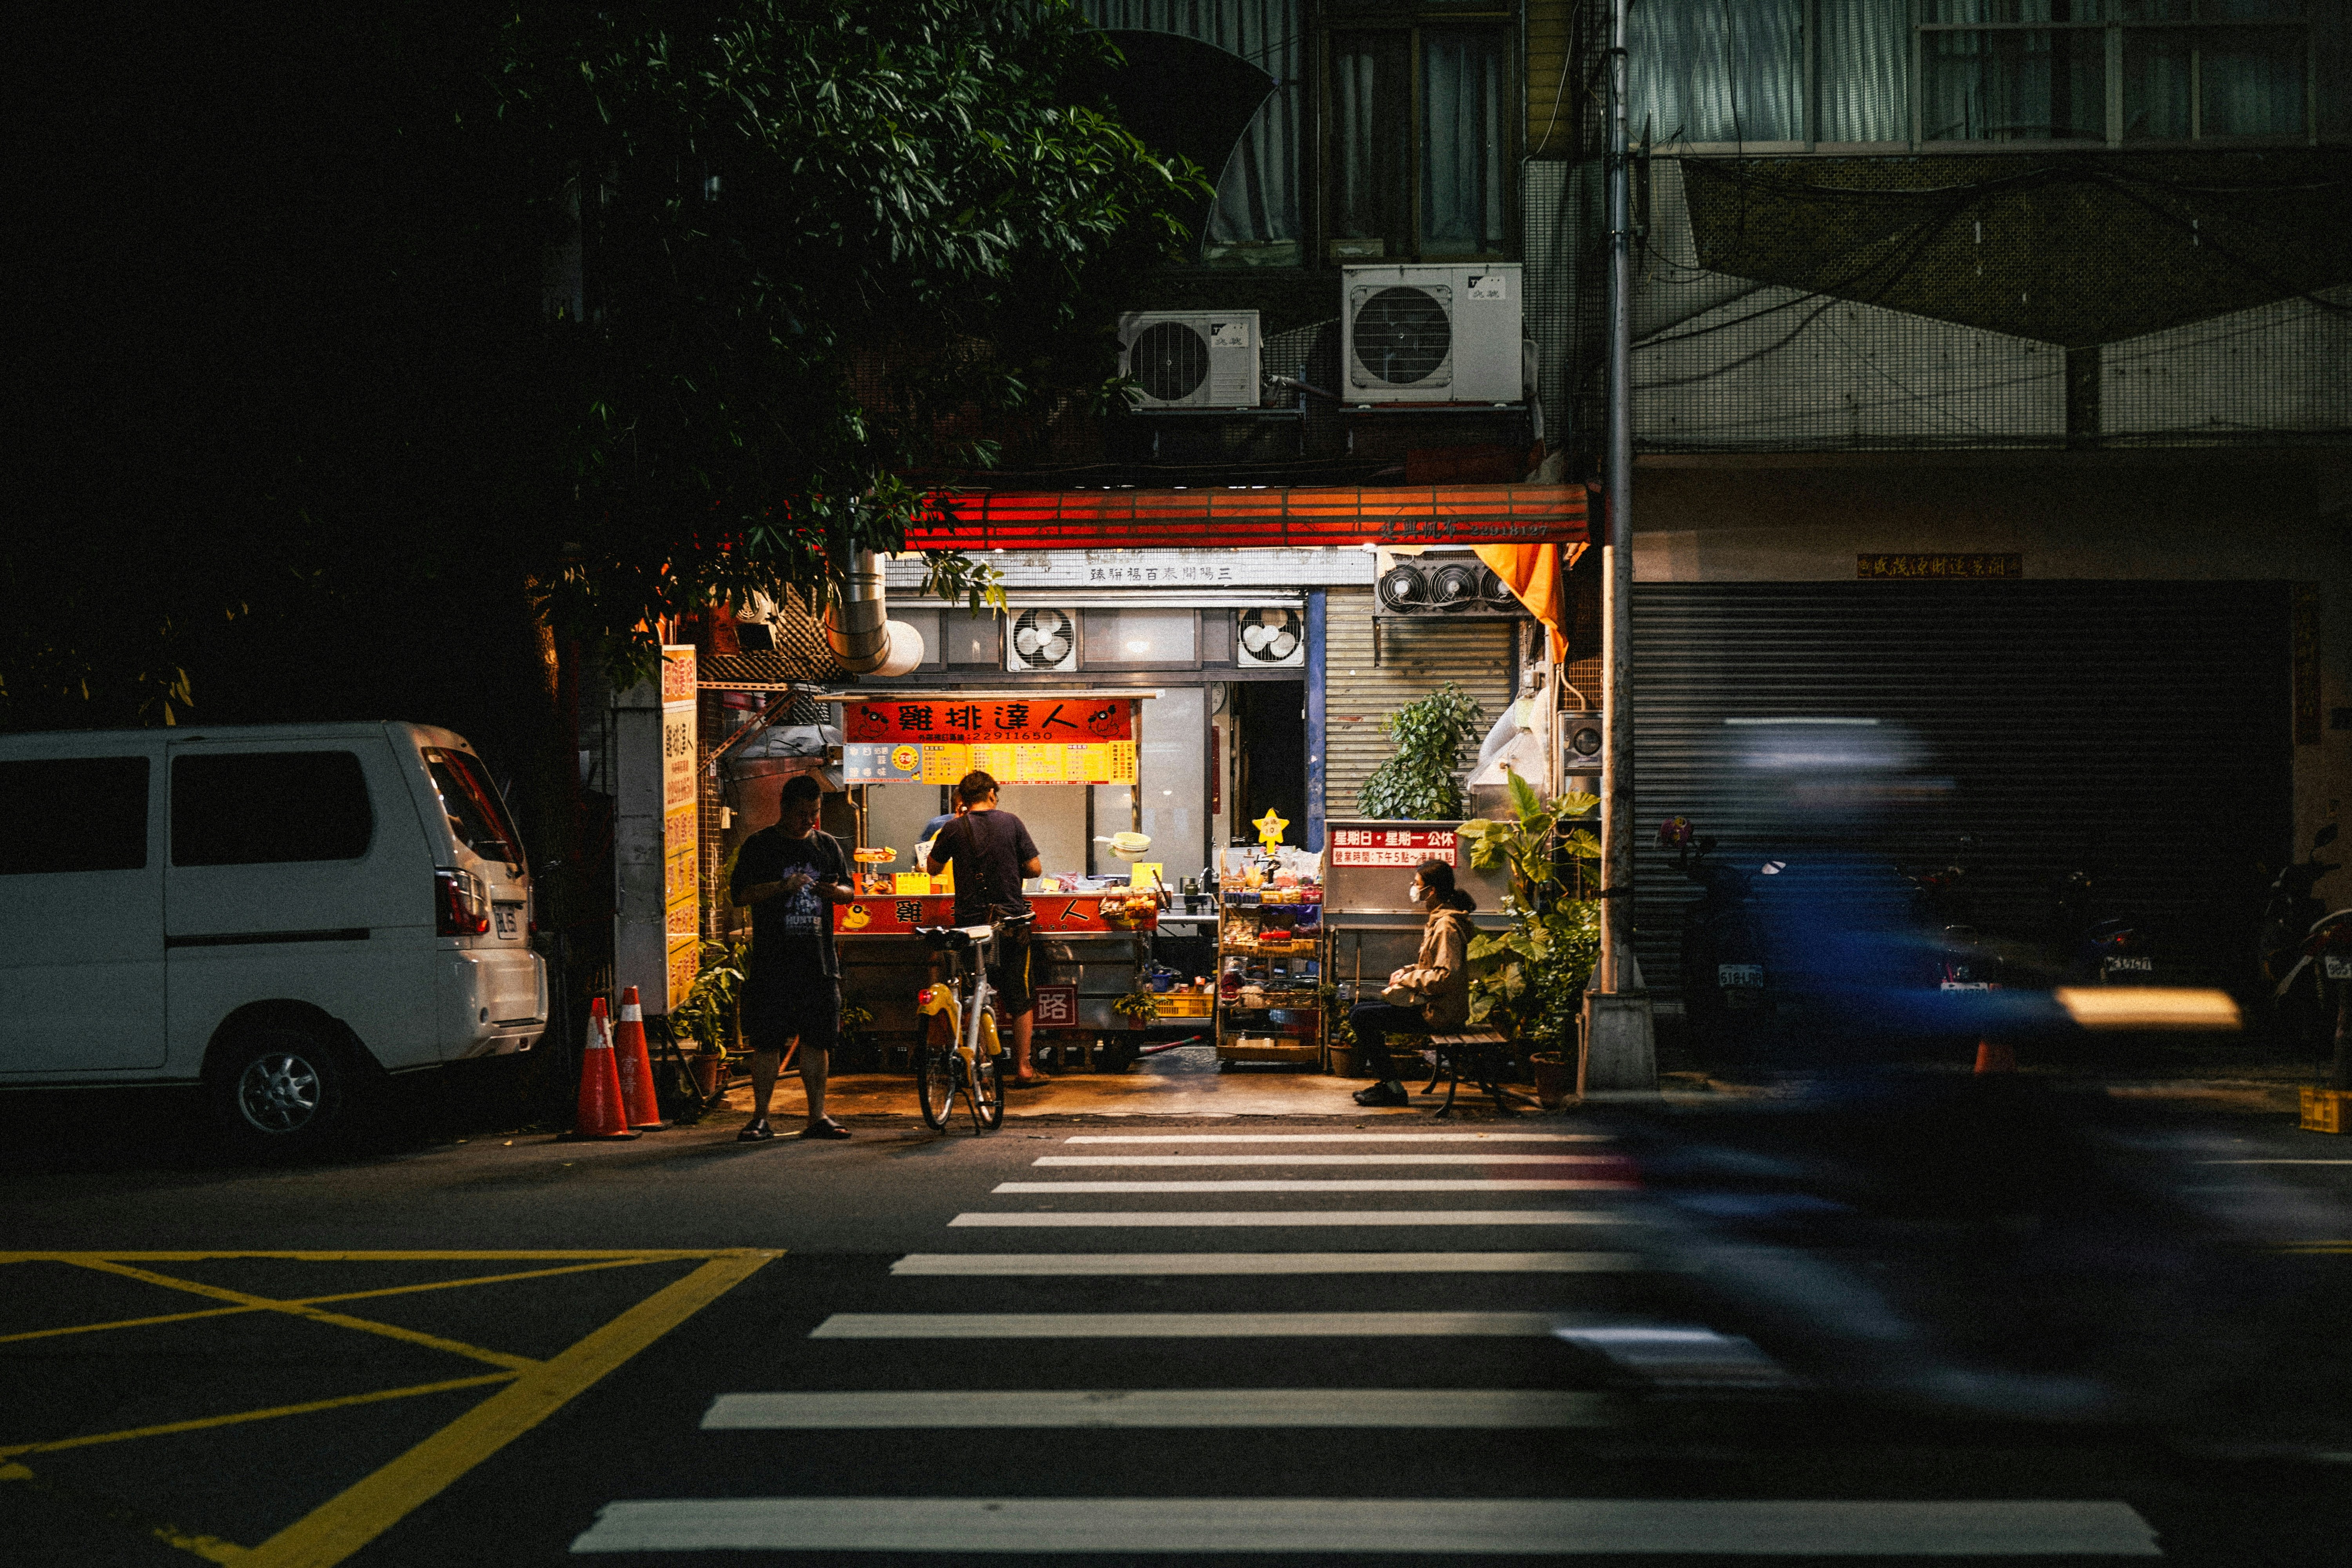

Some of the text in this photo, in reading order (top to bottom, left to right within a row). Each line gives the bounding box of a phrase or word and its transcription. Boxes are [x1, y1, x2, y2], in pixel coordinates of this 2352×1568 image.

[898, 704, 1078, 731] 雞排達人
[1038, 993, 1067, 1019] 路
